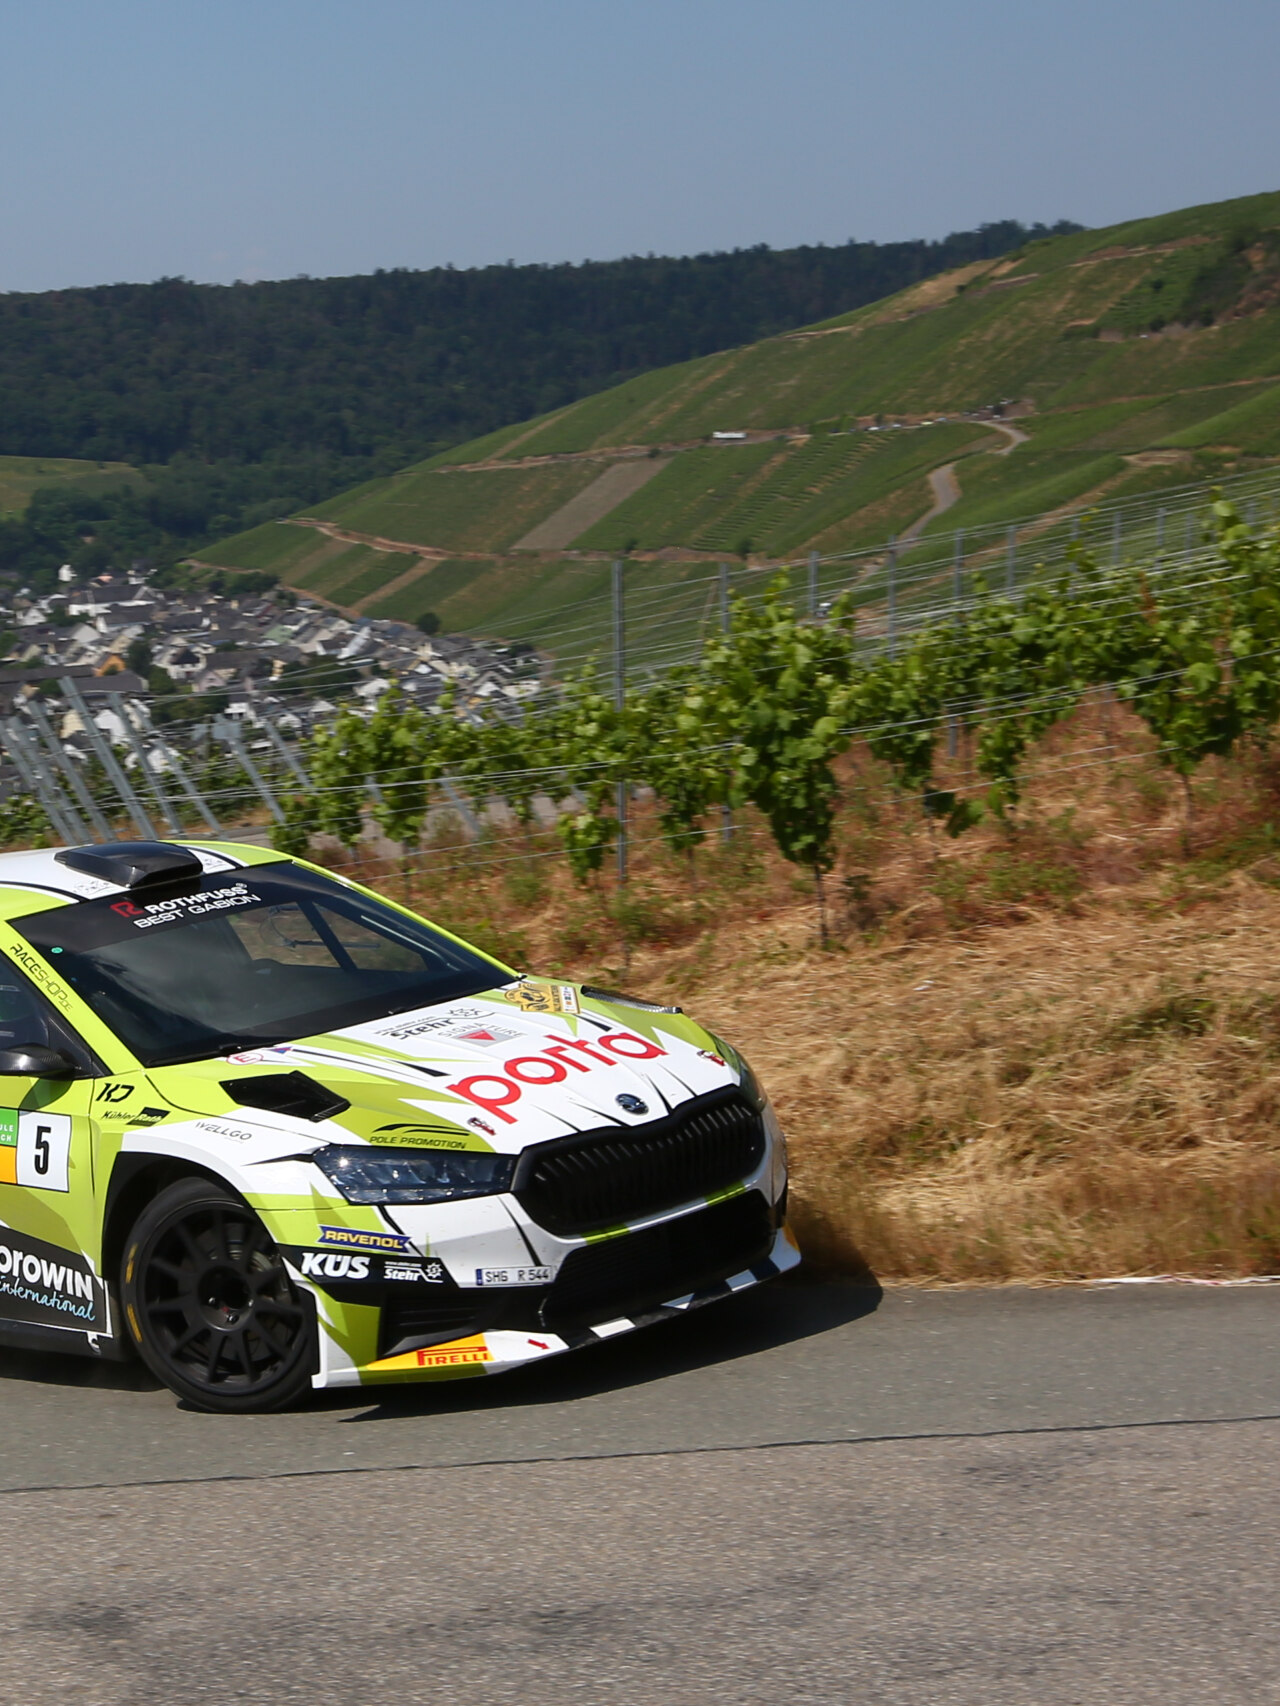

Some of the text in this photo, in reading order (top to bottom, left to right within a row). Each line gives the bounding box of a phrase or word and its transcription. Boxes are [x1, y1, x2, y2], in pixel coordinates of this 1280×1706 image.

[133, 894, 261, 929] BEST GABION
[389, 1018, 457, 1040] Stehr
[446, 1032, 669, 1125] porta
[195, 1121, 253, 1141] WELLGO
[34, 1125, 52, 1175] 5
[370, 1136, 468, 1150] POLE PROMOTION
[324, 1230, 404, 1249] RAVENOL
[300, 1252, 370, 1280] KÜS
[383, 1268, 421, 1281] Stehr
[517, 1269, 527, 1282] R
[528, 1269, 549, 1281] 544
[416, 1346, 488, 1367] PIRELLI
